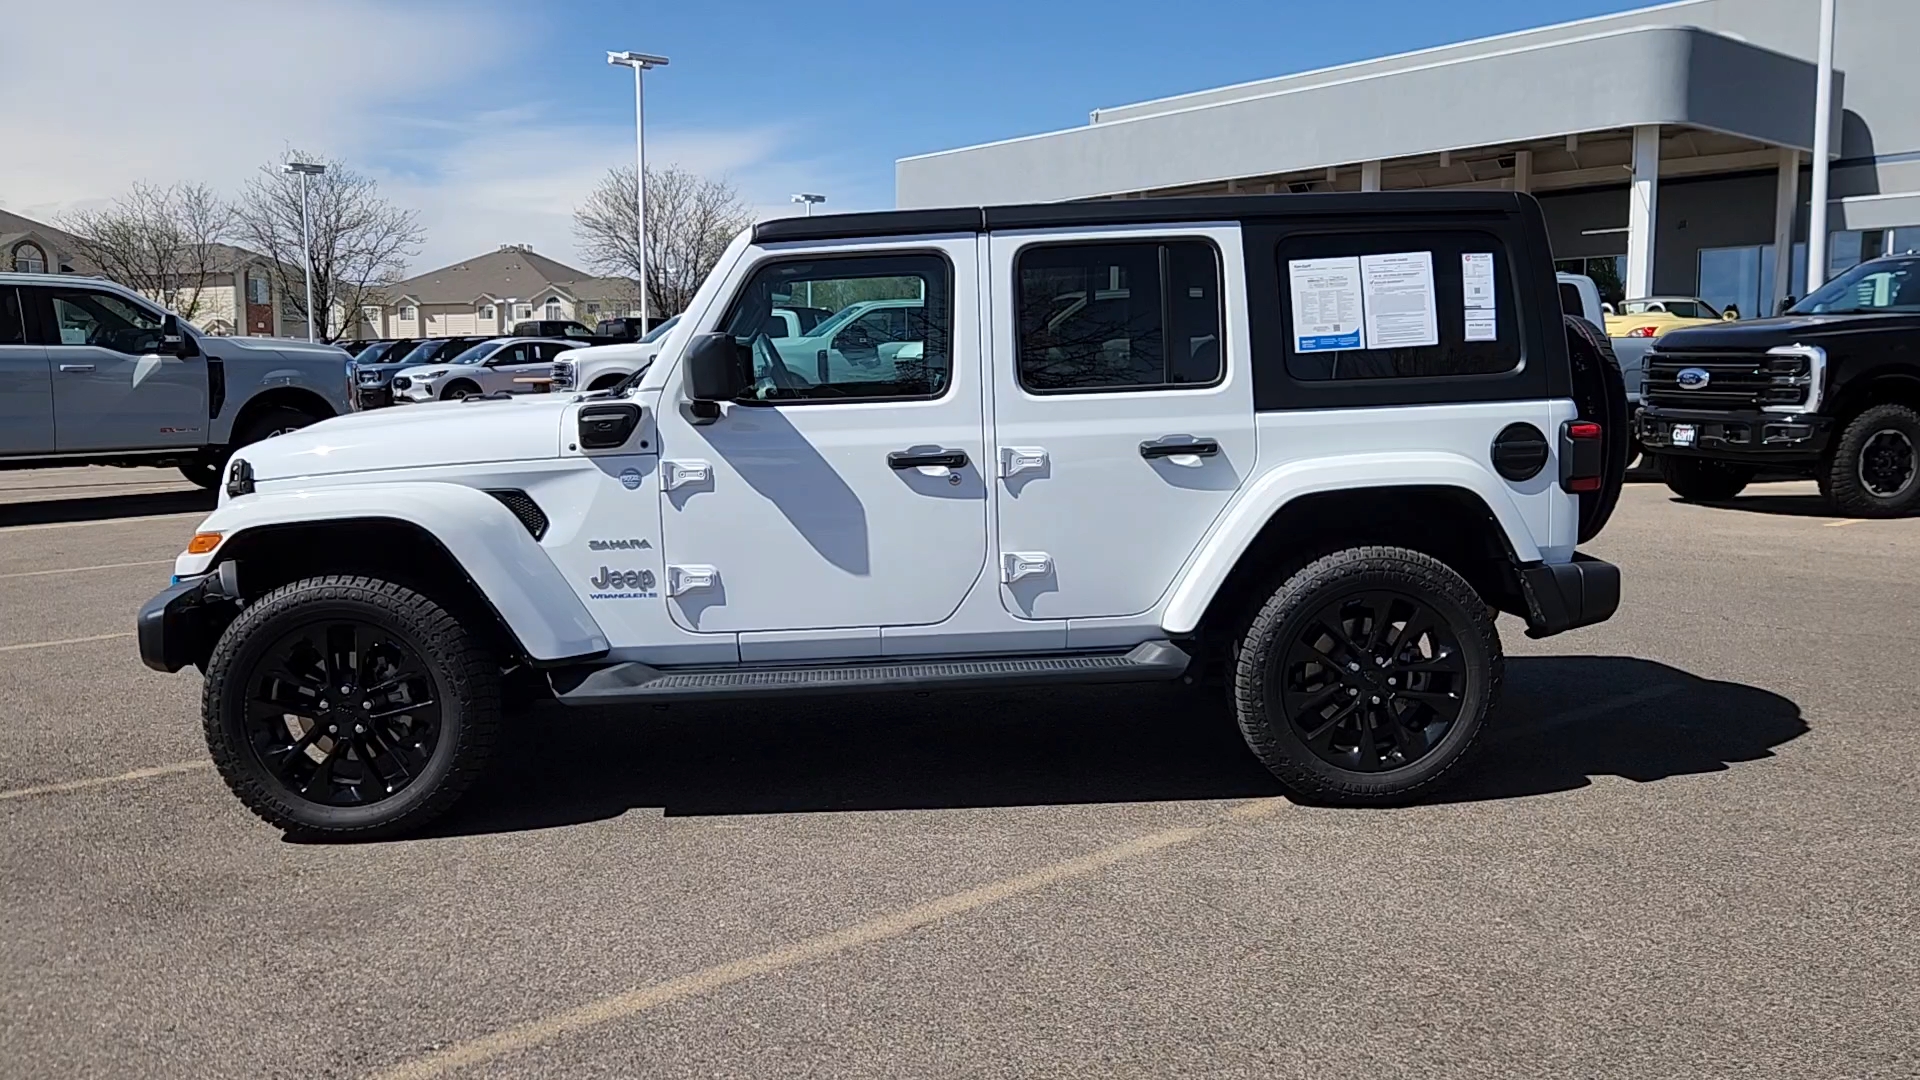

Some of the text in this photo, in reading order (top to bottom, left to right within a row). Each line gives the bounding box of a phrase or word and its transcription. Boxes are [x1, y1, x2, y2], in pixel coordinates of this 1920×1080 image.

[588, 538, 654, 551] SAHARA
[590, 565, 656, 592] Jeep
[589, 592, 647, 600] WRANGLER
